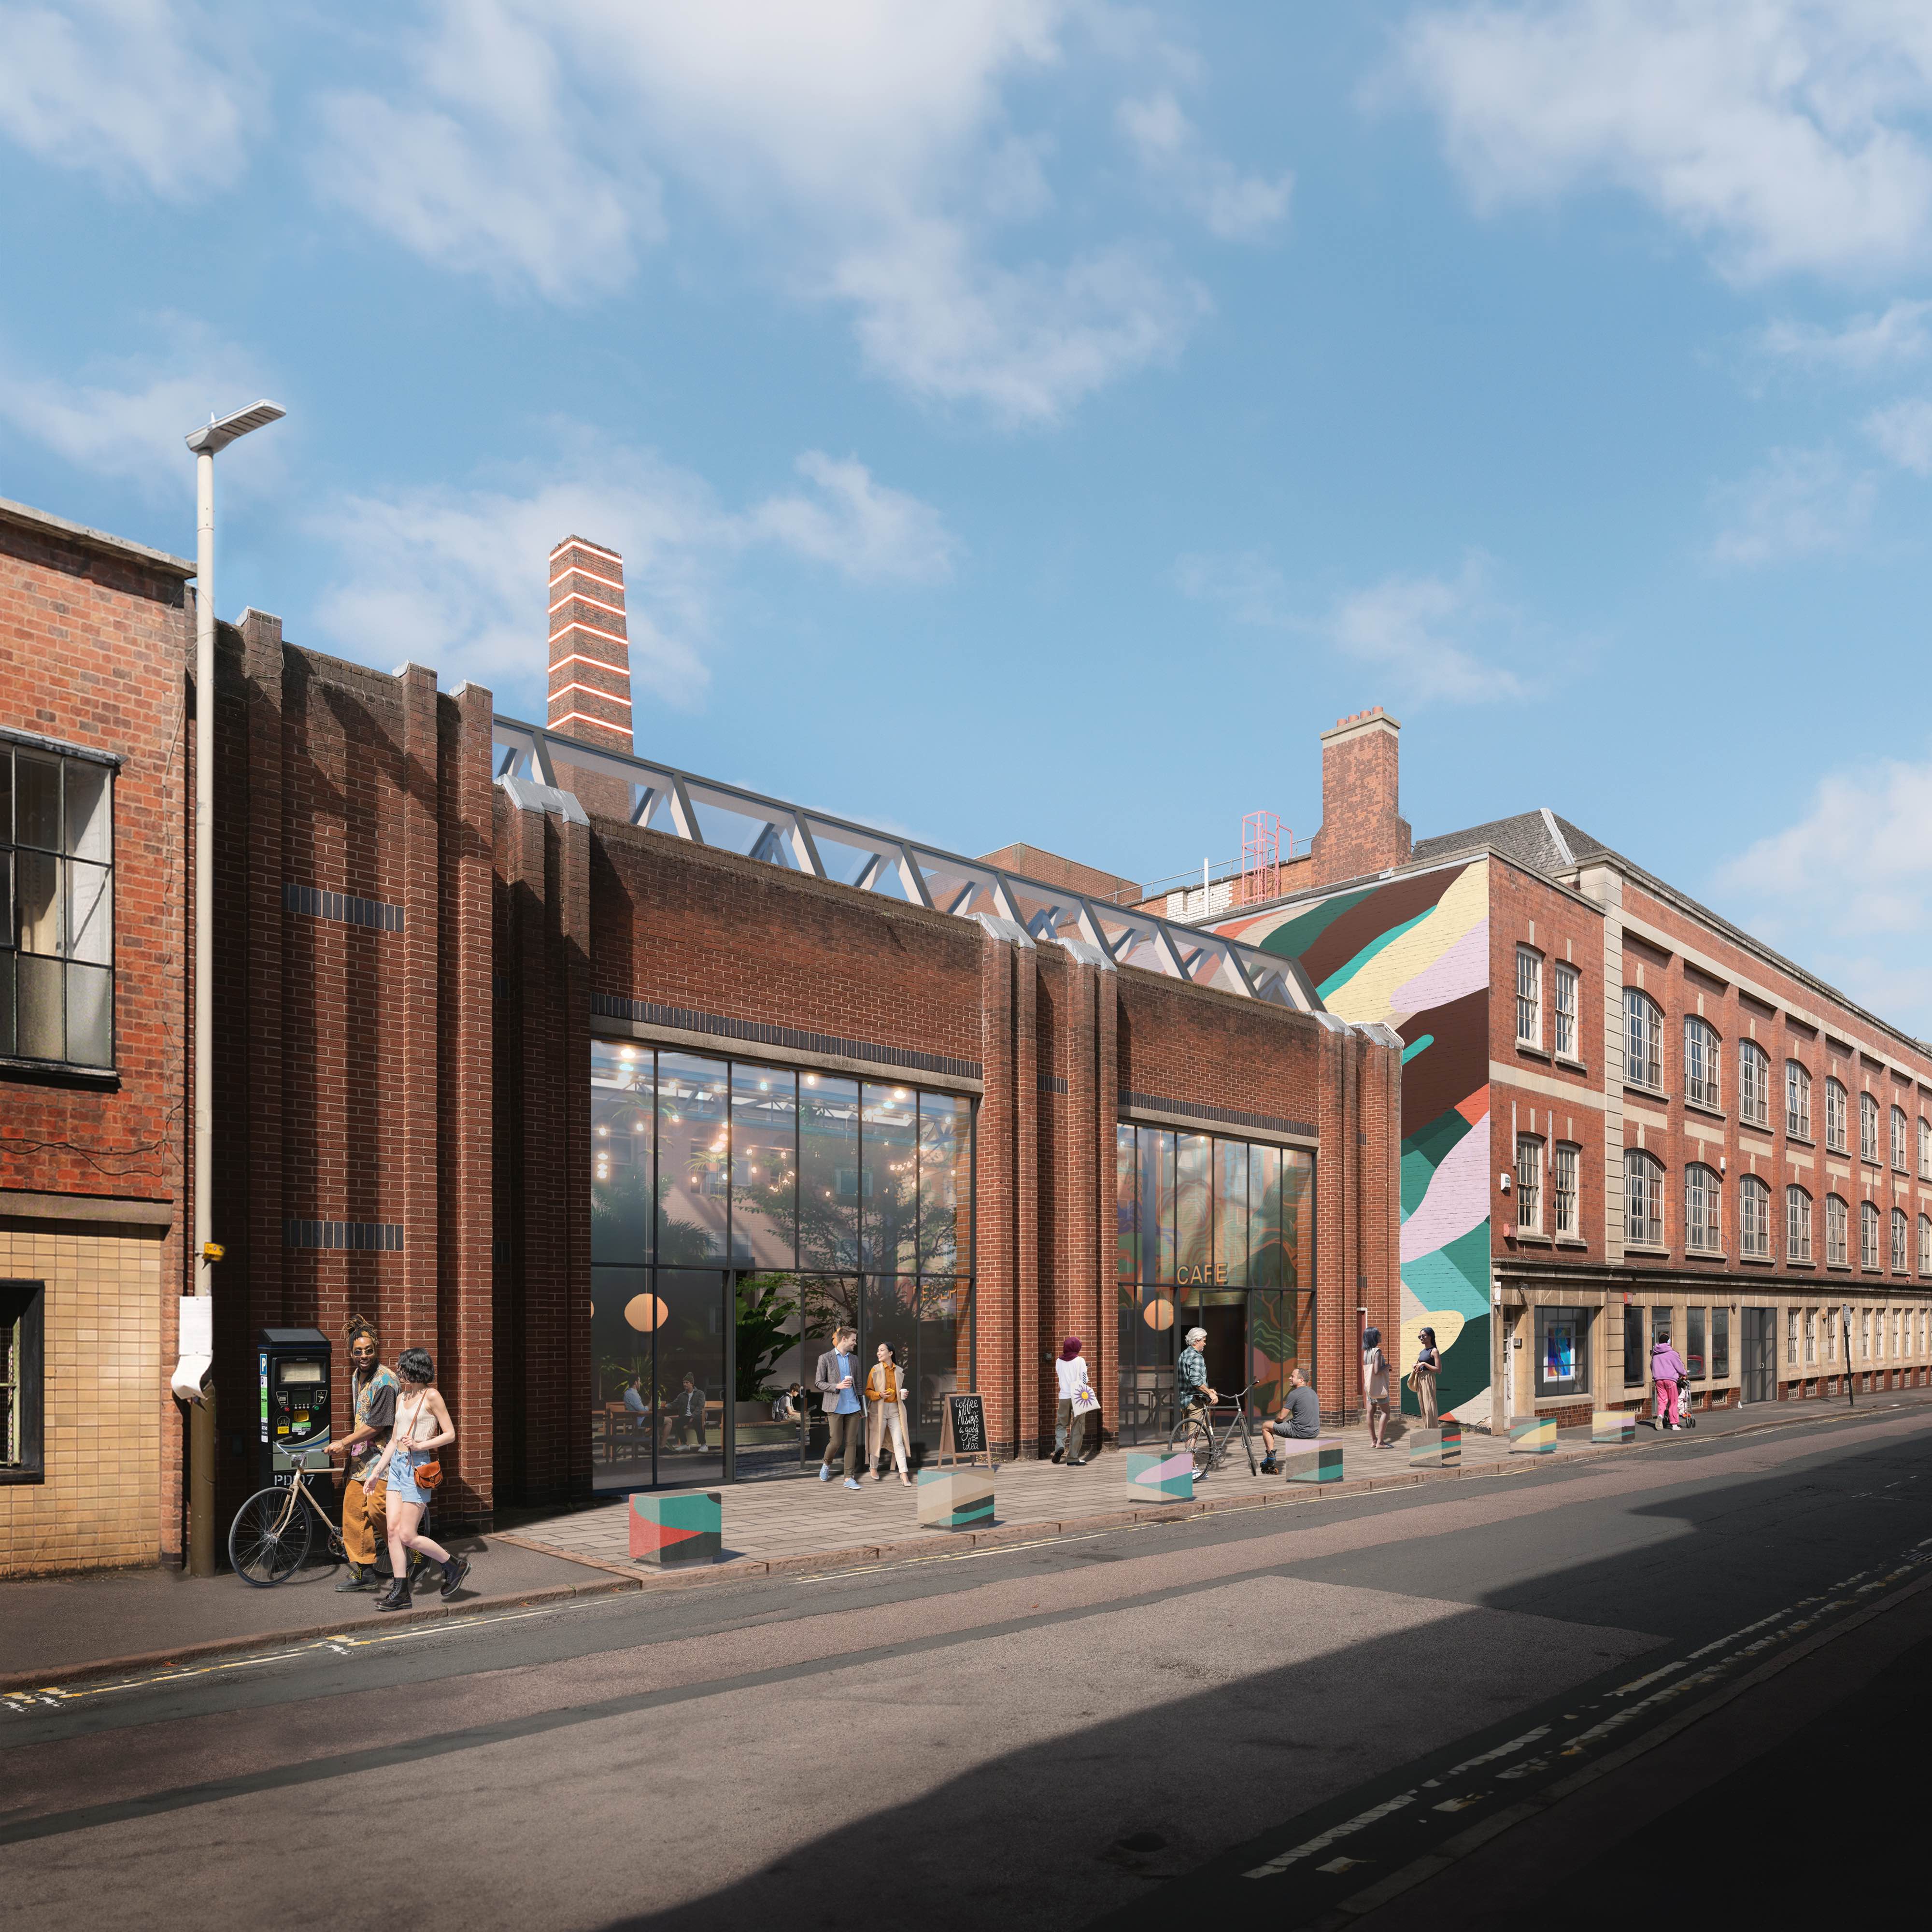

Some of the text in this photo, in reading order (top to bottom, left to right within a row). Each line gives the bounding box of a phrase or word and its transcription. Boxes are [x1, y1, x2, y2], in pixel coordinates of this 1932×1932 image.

[1177, 1263, 1227, 1285] CAFE
[262, 1357, 266, 1372] P
[955, 1398, 979, 1415] Coffee
[961, 1424, 979, 1441] good
[963, 1437, 979, 1450] idea
